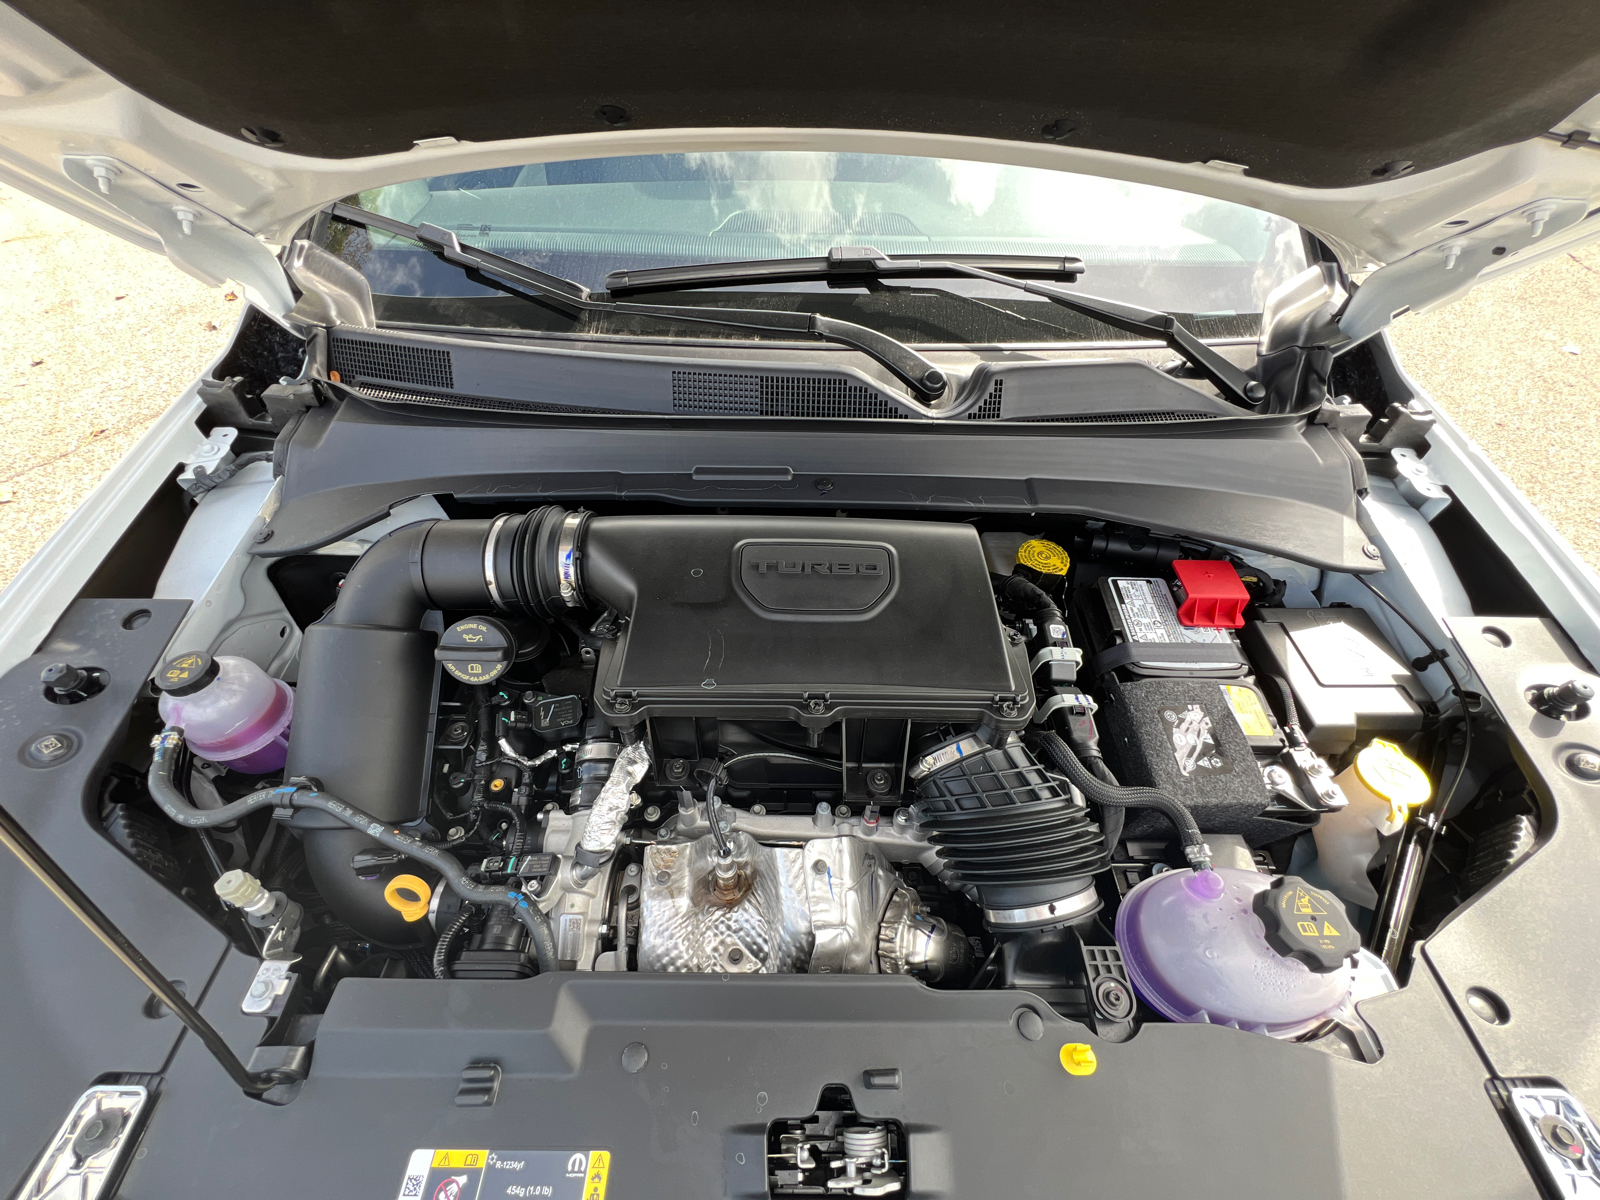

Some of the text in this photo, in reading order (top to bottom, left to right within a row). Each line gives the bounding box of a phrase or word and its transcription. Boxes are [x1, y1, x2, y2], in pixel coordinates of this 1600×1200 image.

[750, 560, 883, 575] TURBO
[456, 623, 487, 632] ENGINE OIL
[495, 1161, 524, 1170] R-1234yf
[506, 1186, 553, 1197] 454g (1.0 lb)
